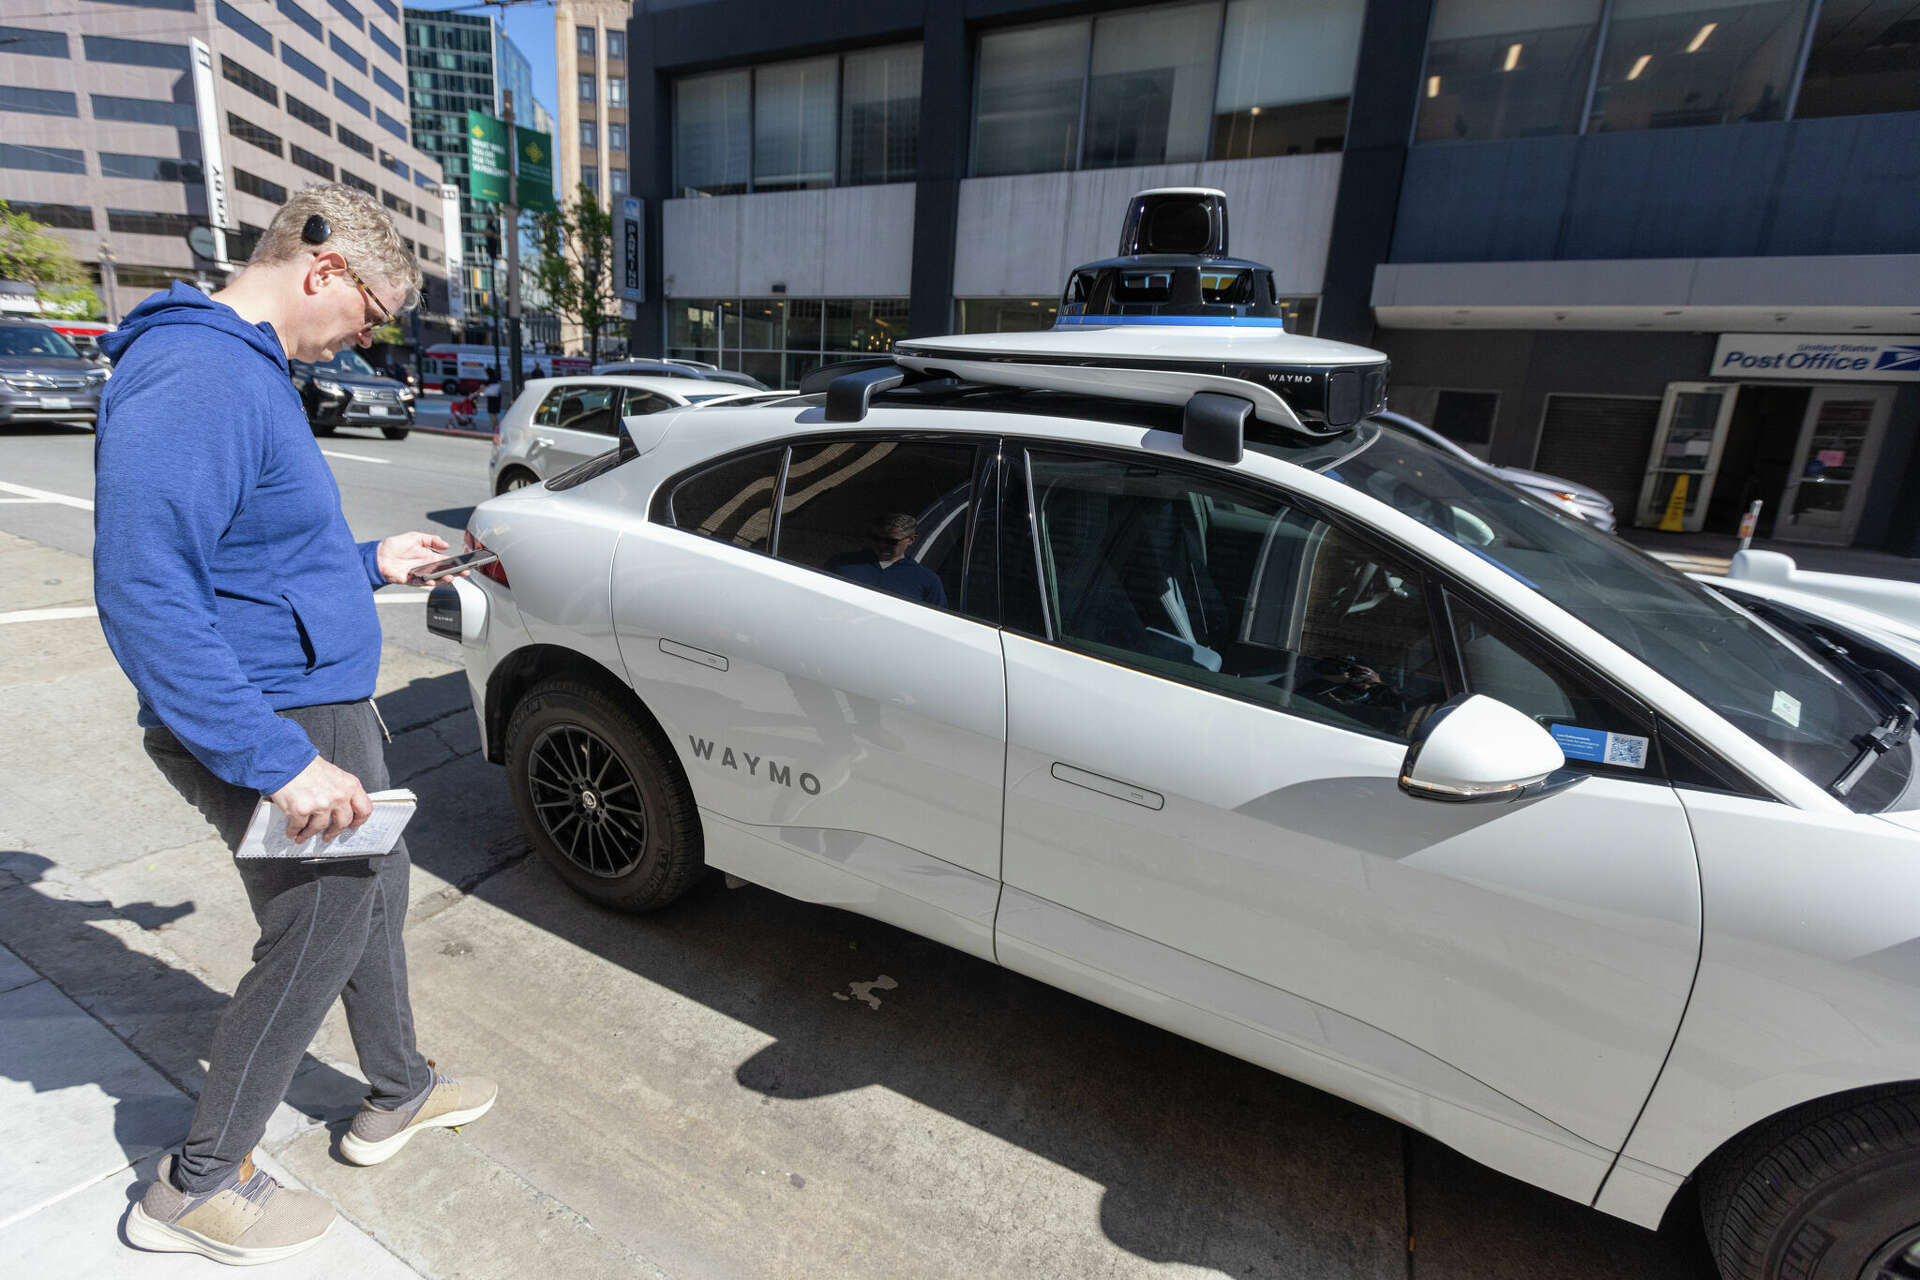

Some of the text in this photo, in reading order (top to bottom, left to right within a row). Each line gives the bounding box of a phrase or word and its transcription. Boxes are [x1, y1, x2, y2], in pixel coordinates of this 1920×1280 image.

[627, 223, 637, 288] PARKING
[1268, 373, 1313, 383] WAYMO
[1722, 351, 1870, 370] Post Office
[689, 735, 821, 795] WAYMO
